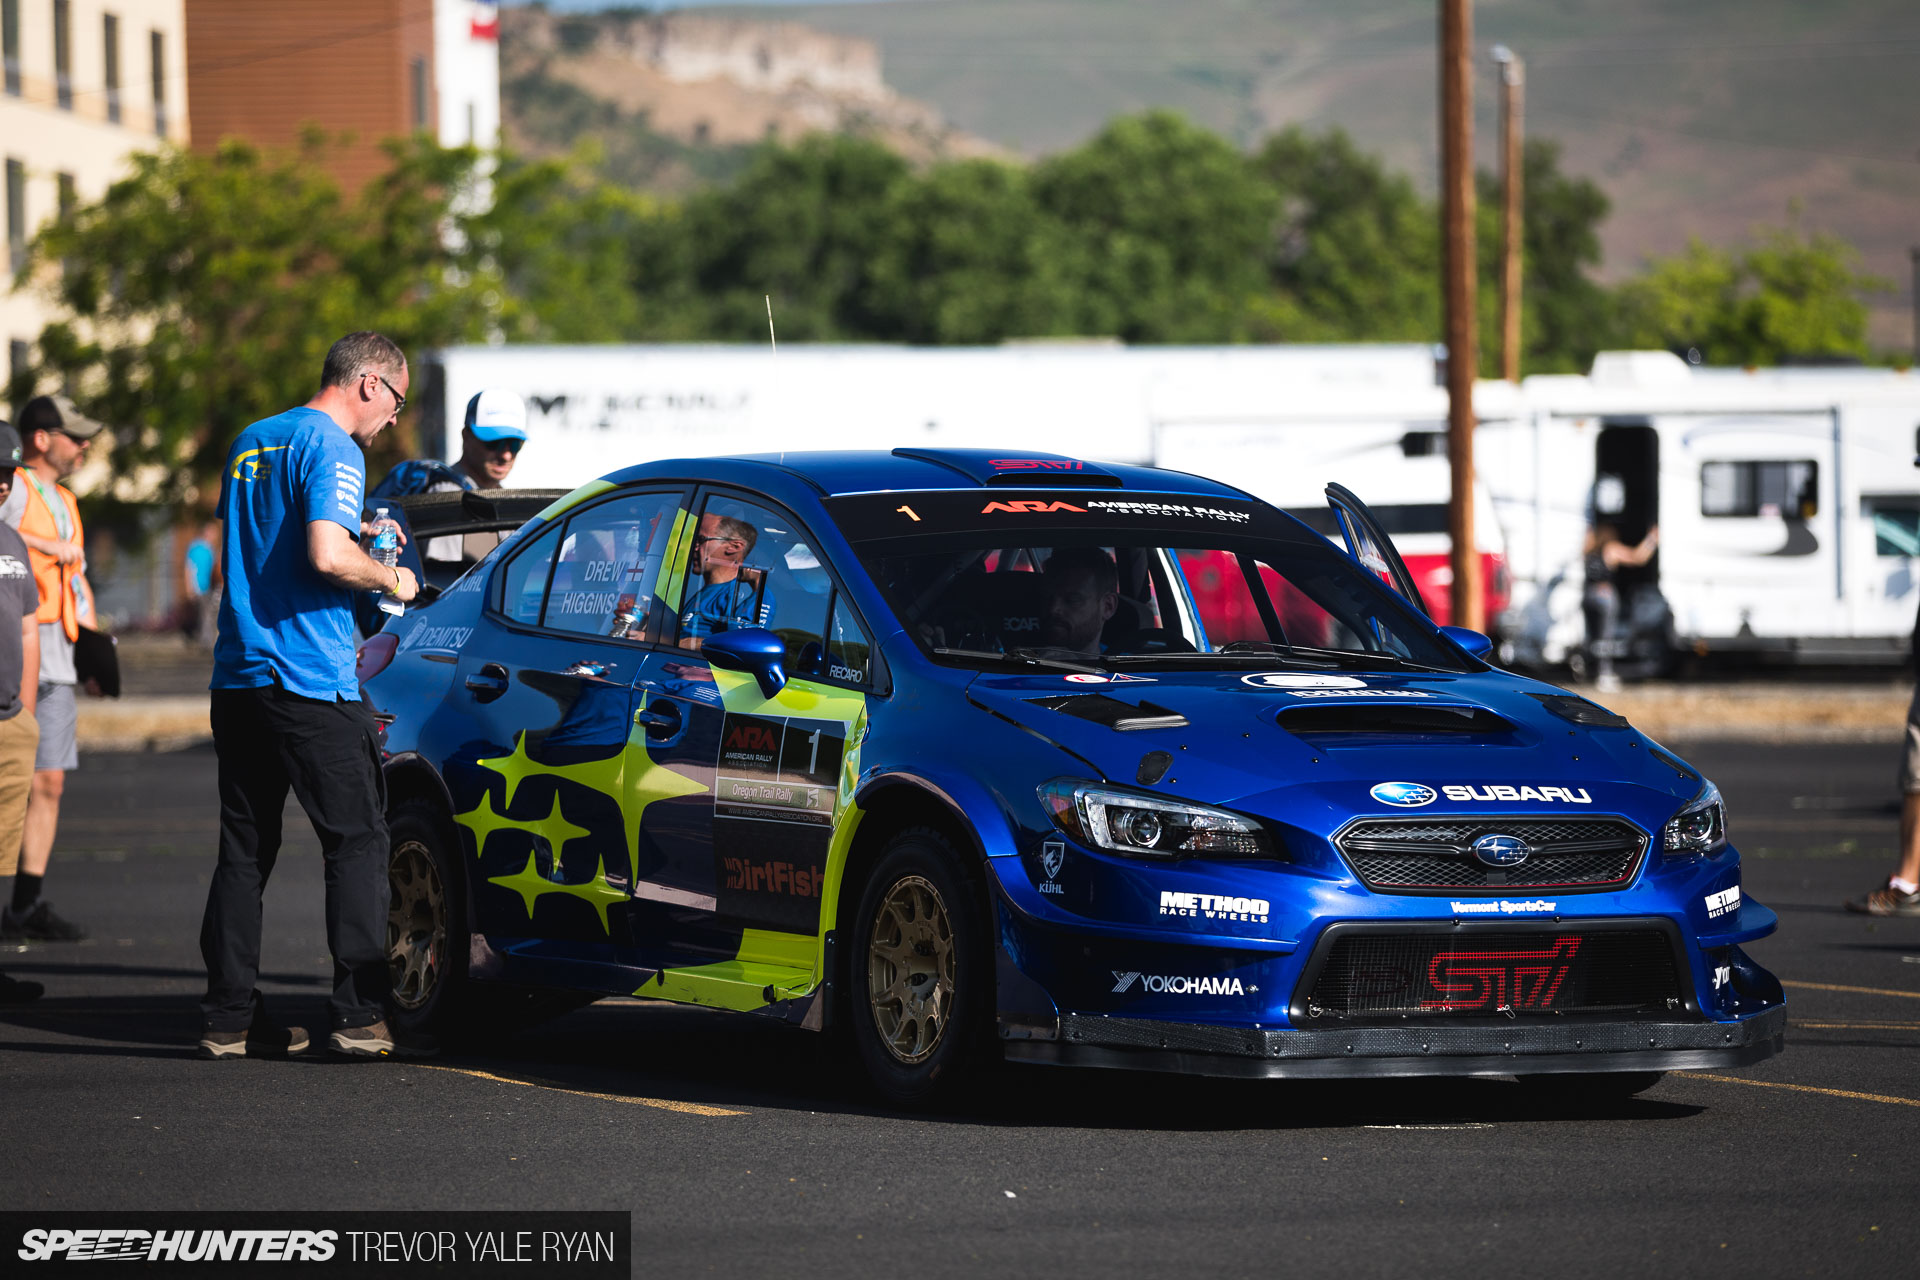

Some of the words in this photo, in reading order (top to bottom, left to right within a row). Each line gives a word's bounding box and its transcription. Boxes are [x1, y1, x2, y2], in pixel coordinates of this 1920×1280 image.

[896, 505, 921, 522] 1
[981, 501, 1088, 514] ARA
[1087, 501, 1191, 512] AMERICAN
[1193, 506, 1250, 520] RALLY
[584, 560, 625, 581] DREW
[561, 592, 615, 614] HIGGINS
[416, 626, 474, 648] IDEMITSU
[829, 665, 863, 683] RECARO
[724, 726, 776, 751] ARA
[725, 752, 754, 761] AMERICAN
[755, 754, 773, 762] RALLY
[808, 729, 821, 774] 1
[732, 784, 758, 800] Oregon
[760, 786, 774, 799] Trail
[776, 787, 794, 803] Rally
[1442, 785, 1592, 804] SUBARU
[1160, 891, 1270, 916] METHOD
[1450, 902, 1499, 913] Vermont
[1500, 900, 1556, 914] SportsCar
[1708, 907, 1724, 919] RACE
[1160, 907, 1197, 917] RACE
[1205, 910, 1269, 924] WHEELS
[1141, 975, 1244, 995] YOKOHAMA
